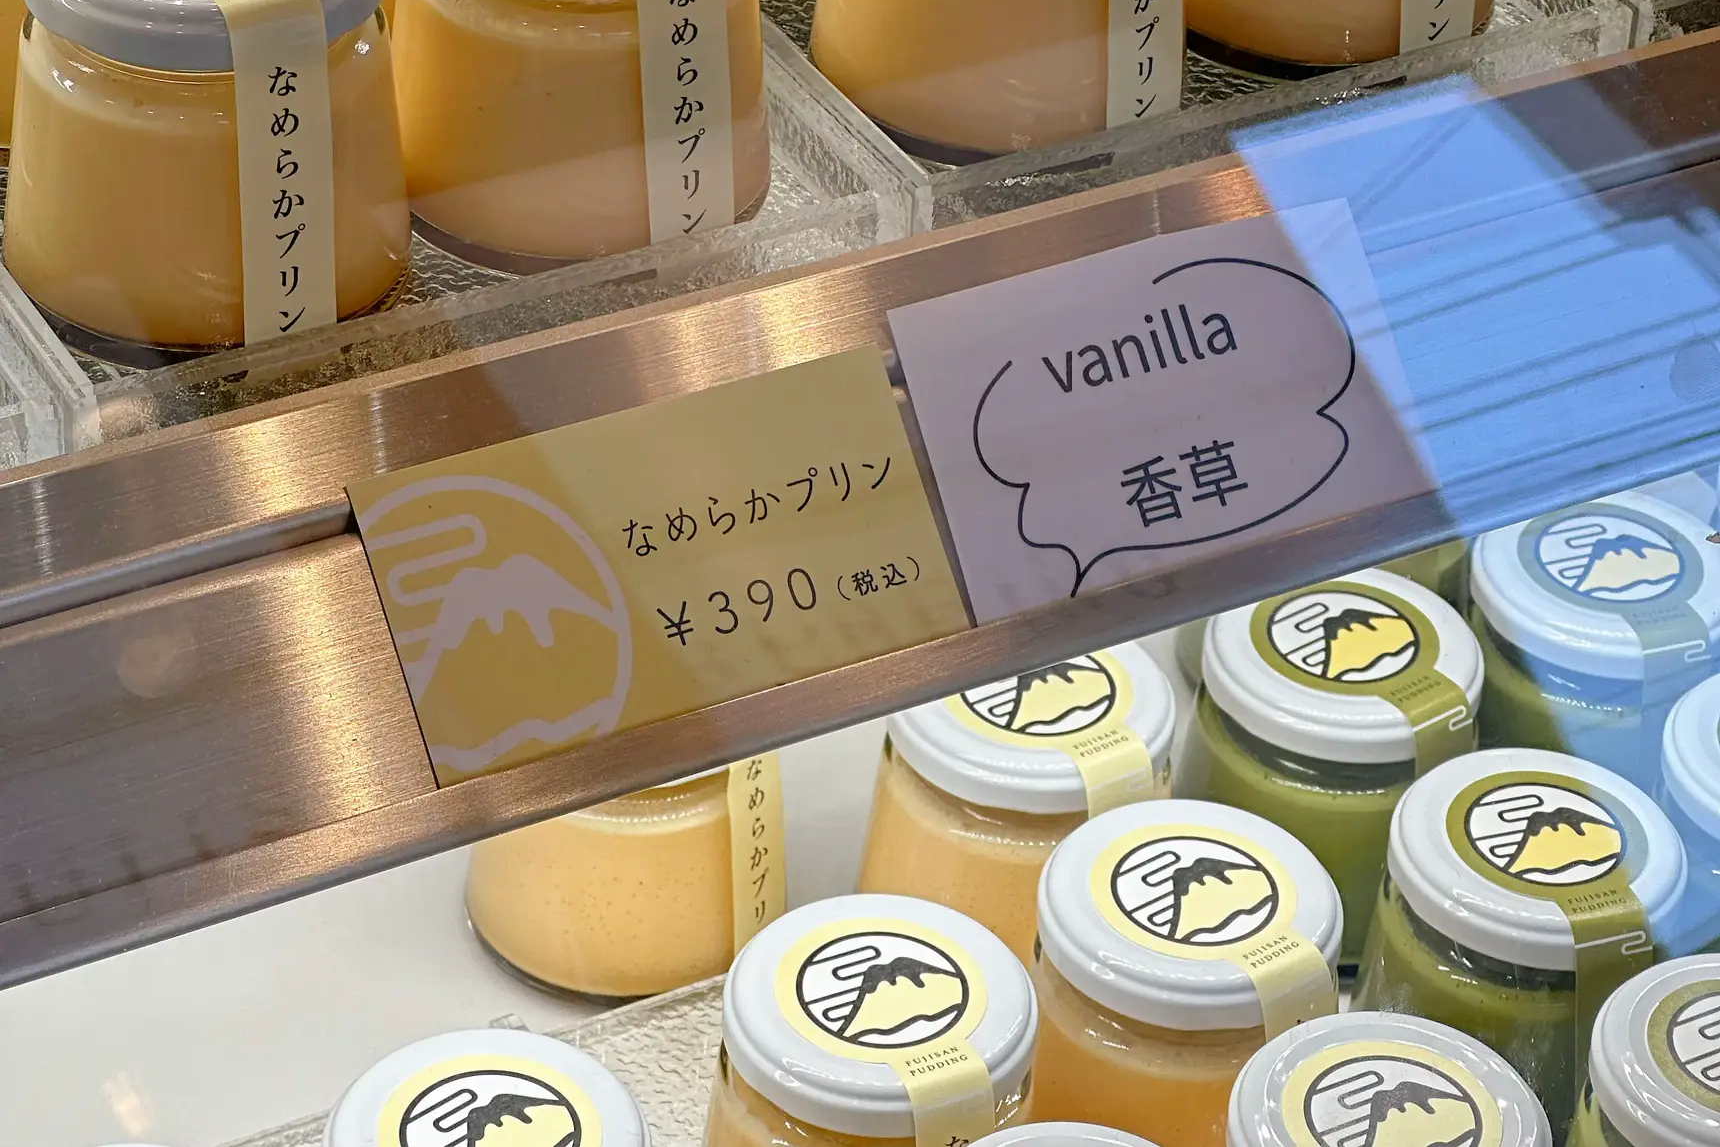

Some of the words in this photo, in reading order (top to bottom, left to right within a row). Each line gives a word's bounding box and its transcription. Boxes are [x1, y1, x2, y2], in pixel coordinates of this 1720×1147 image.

[268, 66, 306, 332] なめらかプリン
[1041, 304, 1238, 393] vanilla
[622, 457, 891, 557] なめらかプリン
[1120, 440, 1249, 528] 香草
[656, 568, 818, 646] ¥390
[837, 556, 921, 601] (税込)
[1080, 735, 1129, 758] PUDDING
[746, 759, 769, 926] なめらかプリ
[1242, 935, 1288, 960] FUJISAN
[1250, 941, 1300, 969] PUDDING
[904, 1046, 959, 1067] FUJISAN
[909, 1054, 968, 1077] PUDDING
